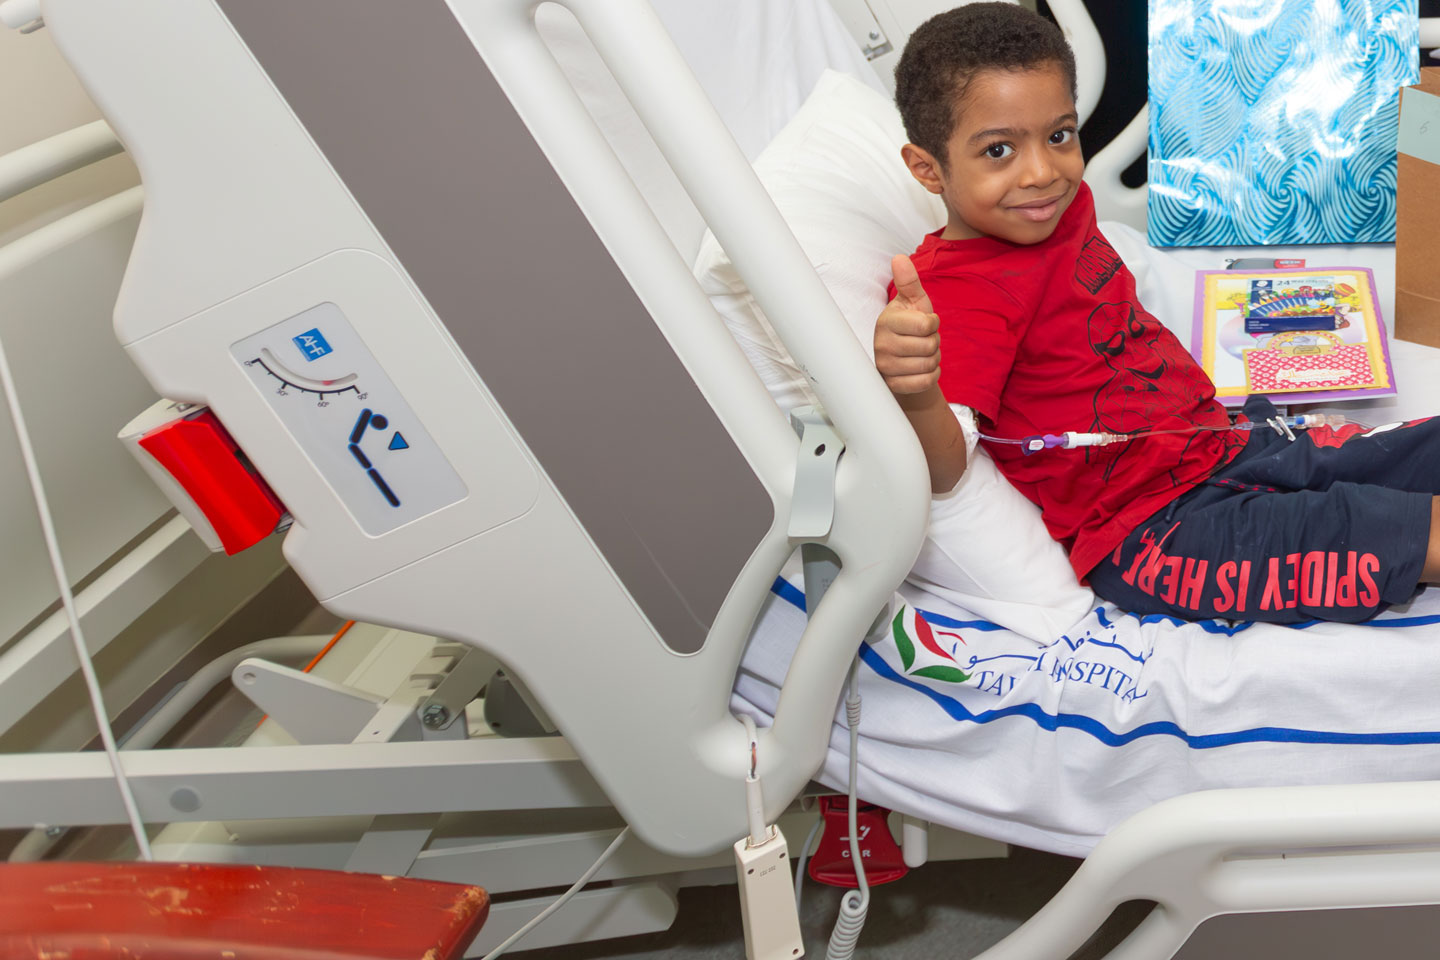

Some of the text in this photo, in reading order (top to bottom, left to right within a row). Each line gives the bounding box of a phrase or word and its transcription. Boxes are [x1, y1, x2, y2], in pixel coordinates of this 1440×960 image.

[1213, 560, 1252, 613] IS
[1260, 551, 1380, 608] SPIDEY
[841, 849, 871, 858] CR
